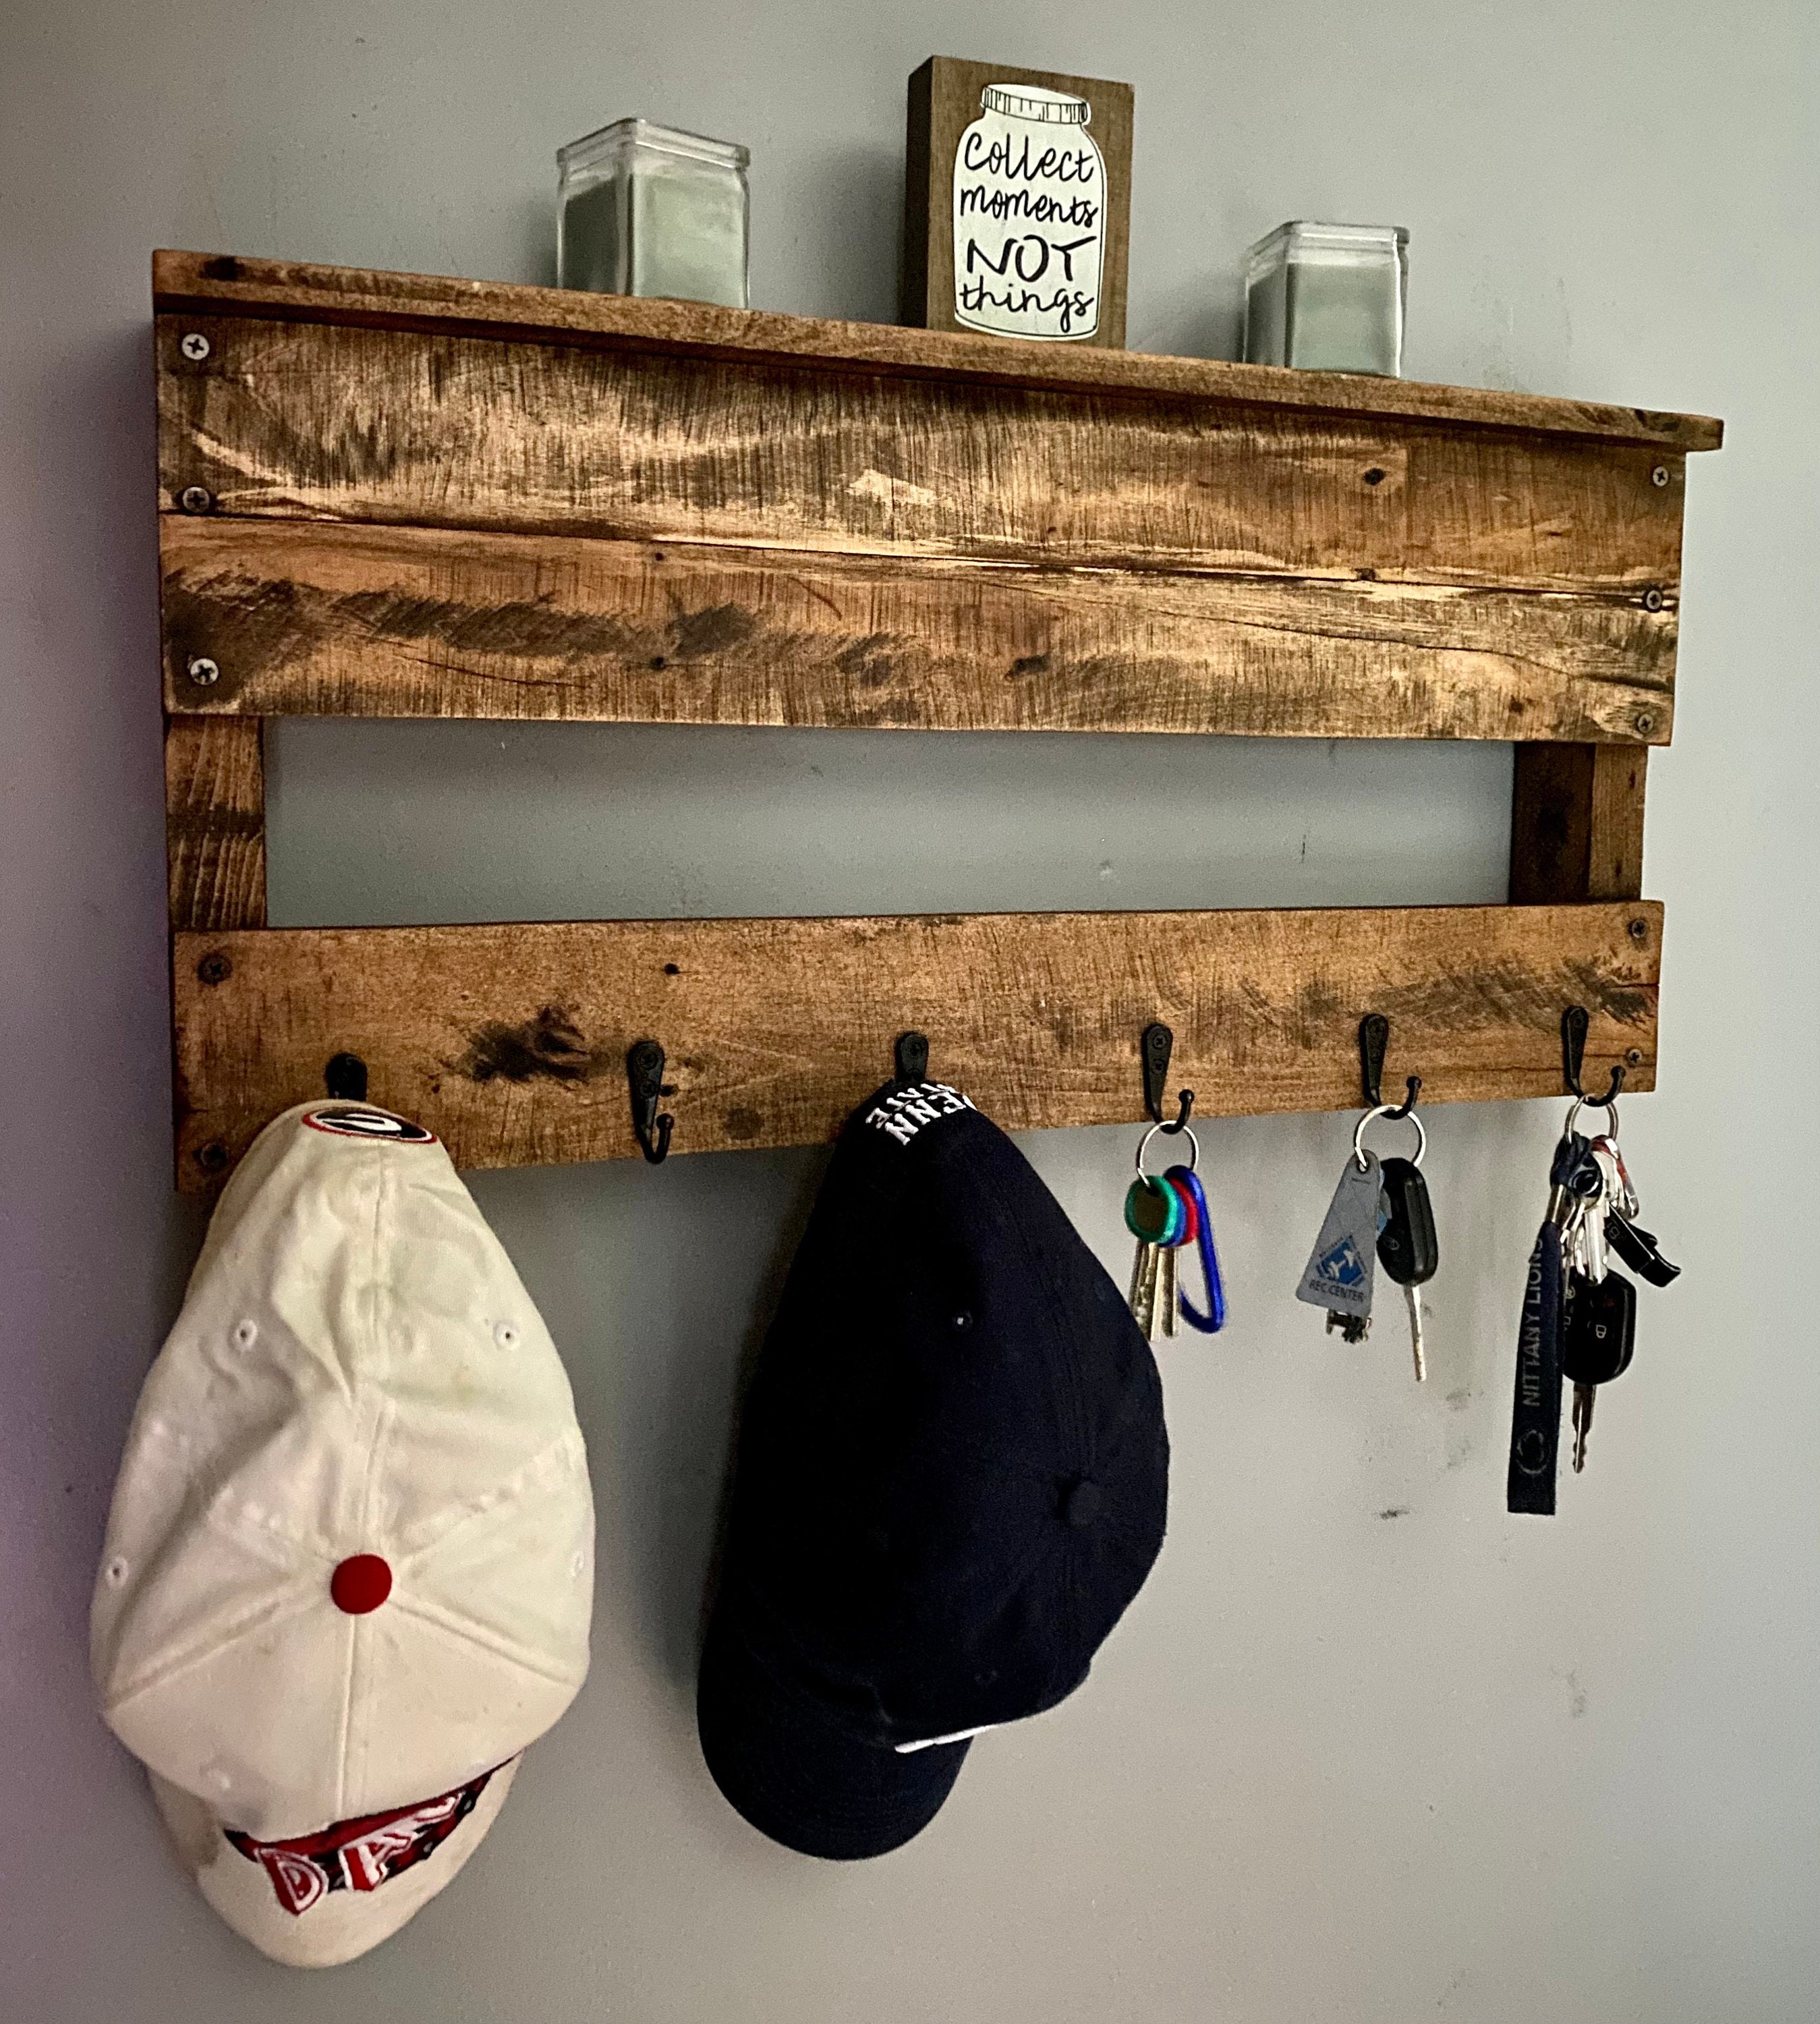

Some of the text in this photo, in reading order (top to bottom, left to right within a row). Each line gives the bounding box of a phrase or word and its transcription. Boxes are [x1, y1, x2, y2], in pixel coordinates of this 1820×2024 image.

[964, 132, 1094, 183] Collect
[960, 185, 1098, 228] moments
[967, 234, 1098, 283] NOT
[959, 275, 1094, 333] things
[1309, 1279, 1364, 1303] REC CENTER
[1522, 1312, 1541, 1407] NITTANY
